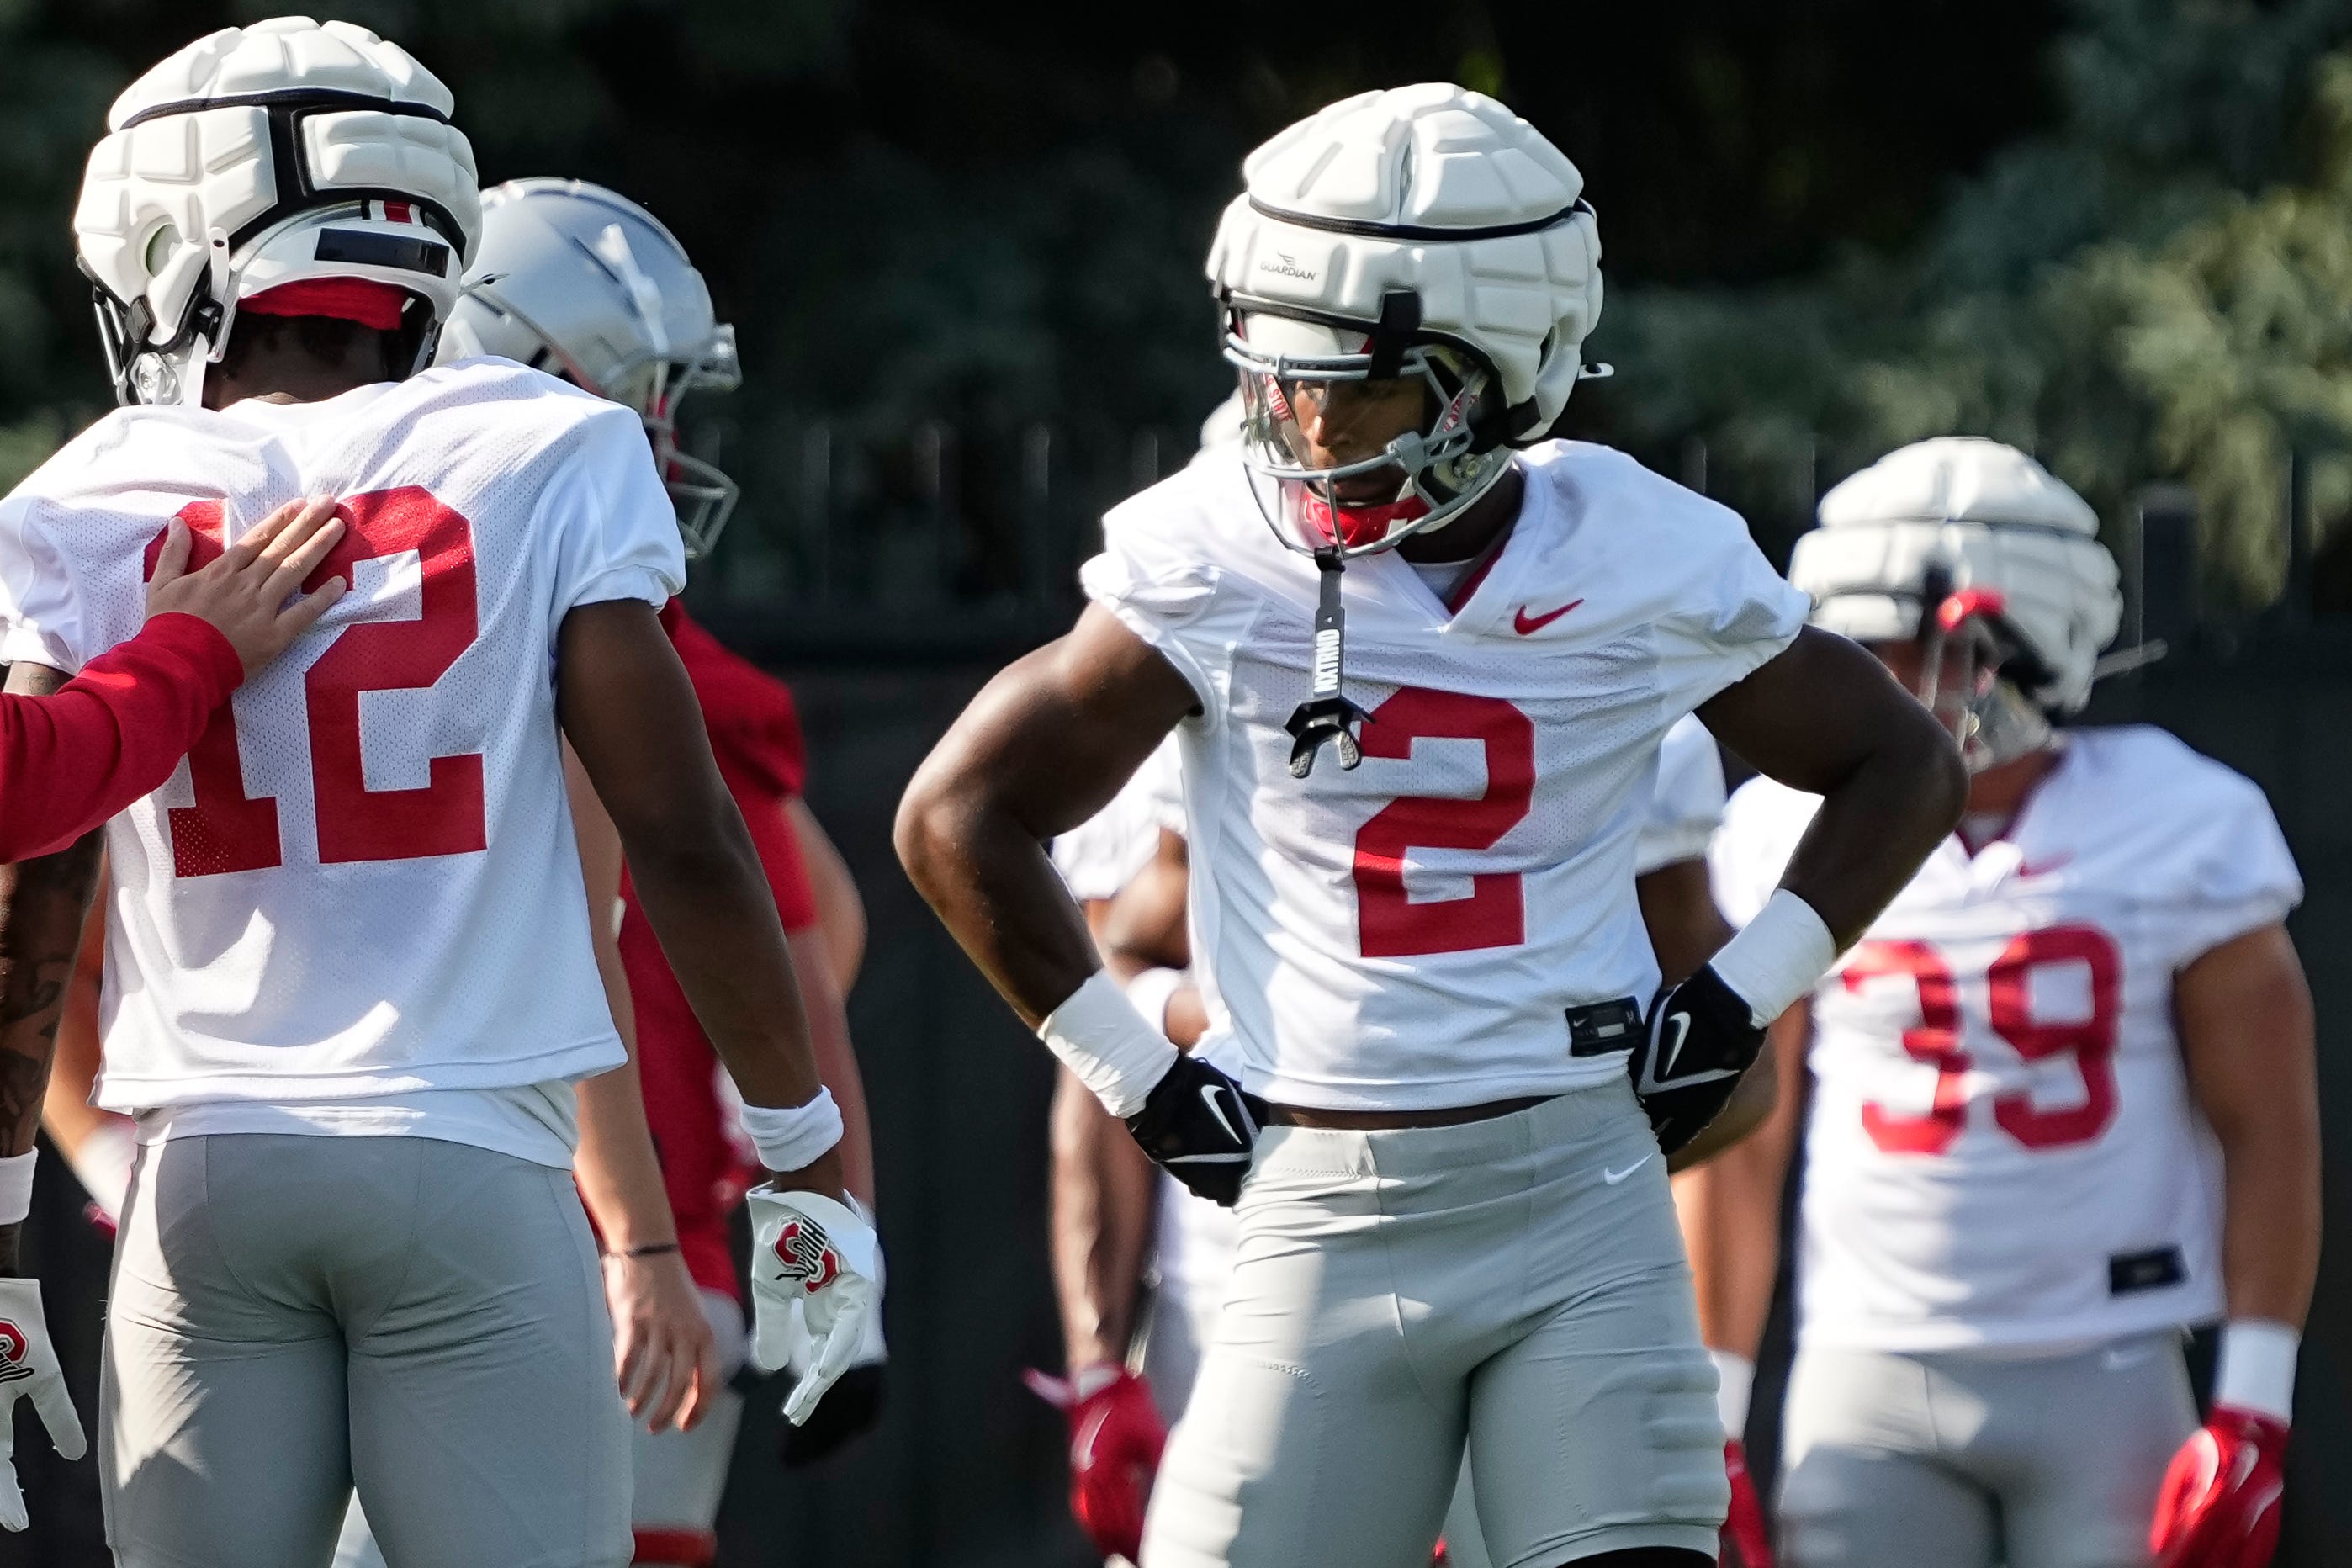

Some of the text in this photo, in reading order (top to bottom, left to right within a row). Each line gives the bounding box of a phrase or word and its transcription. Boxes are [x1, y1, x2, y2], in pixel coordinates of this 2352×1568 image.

[1260, 262, 1316, 281] GUARDIAN
[143, 485, 488, 877] 12
[1313, 629, 1340, 692] NXTRND
[1353, 686, 1538, 957] 2
[1841, 919, 2123, 1155] 39
